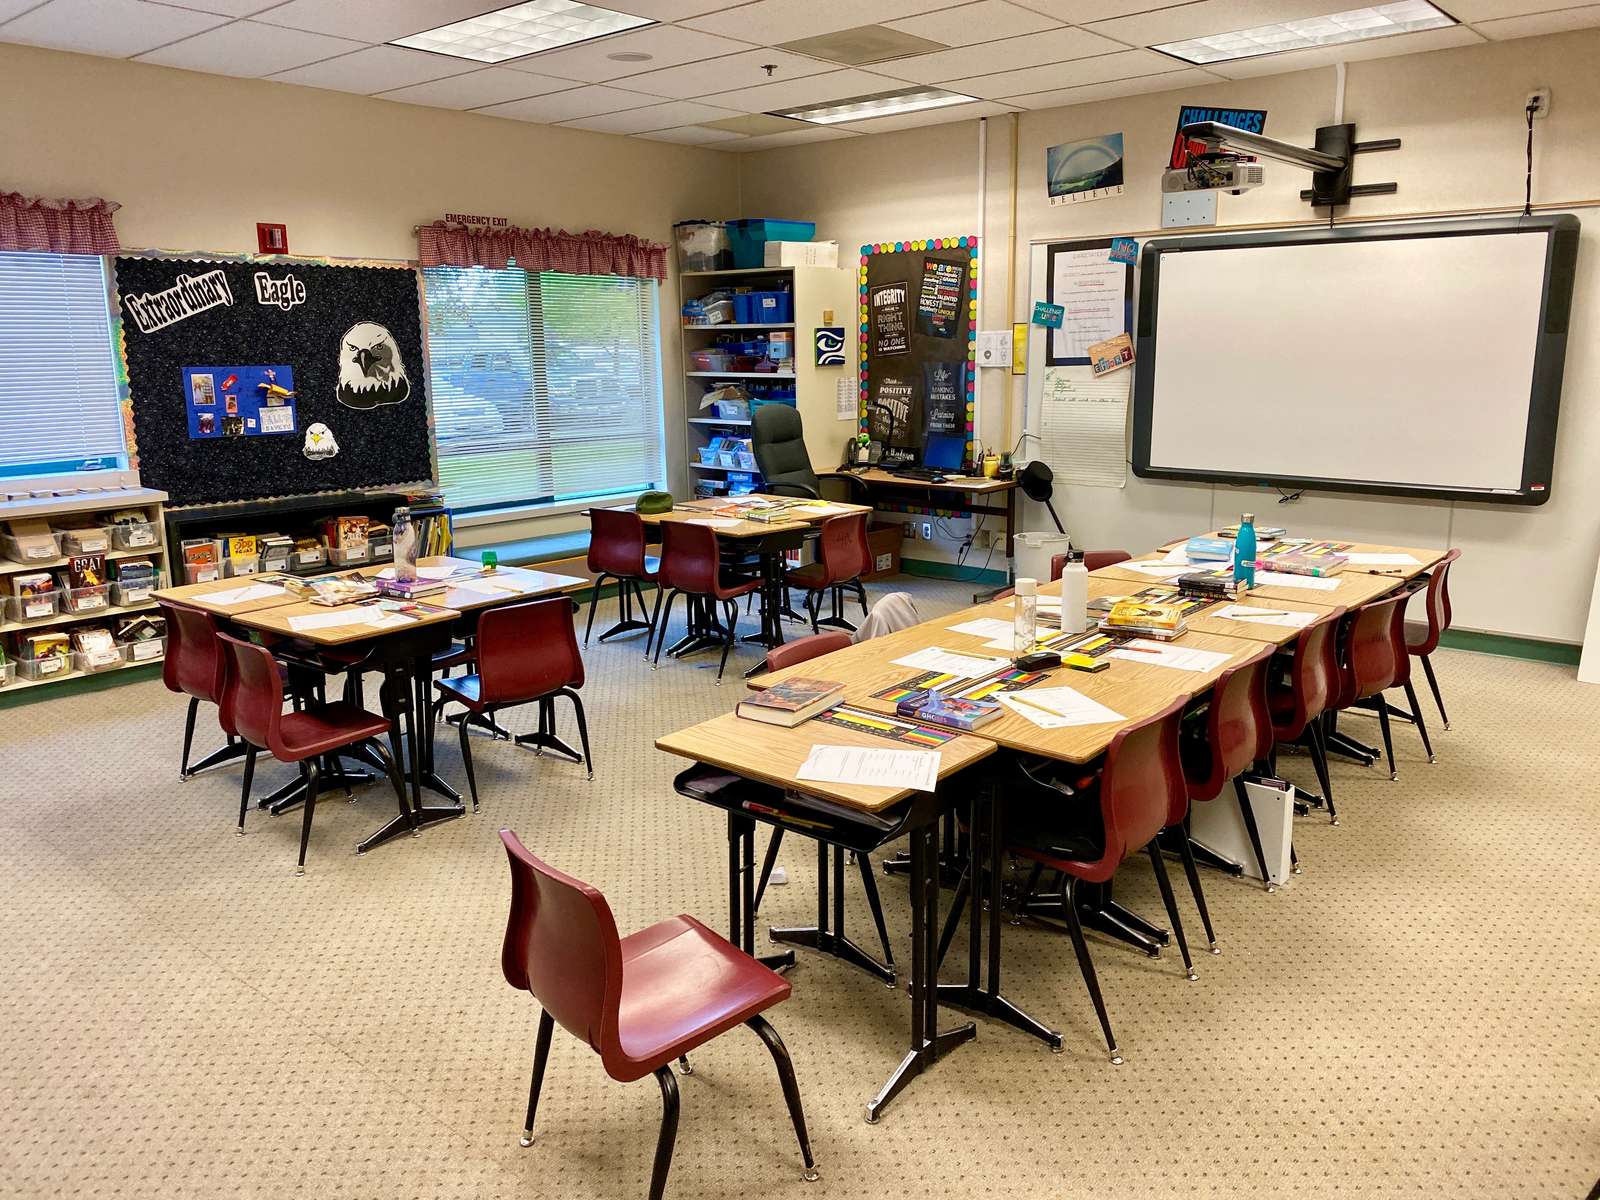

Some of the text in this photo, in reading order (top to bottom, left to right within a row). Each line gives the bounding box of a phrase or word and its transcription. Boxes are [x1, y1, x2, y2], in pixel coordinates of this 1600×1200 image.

[1181, 109, 1262, 132] CHALLENGES
[1050, 185, 1121, 205] BELIEVE
[445, 213, 507, 226] EMERGENCY EXIT
[127, 271, 304, 331] Extraordinary Eagle
[873, 289, 905, 307] INTEGRITY
[878, 312, 902, 323] RIGHT
[890, 337, 905, 346] ONE
[880, 387, 912, 395] POSITIVE
[932, 386, 954, 394] MAKING
[74, 557, 100, 572] GOAT
